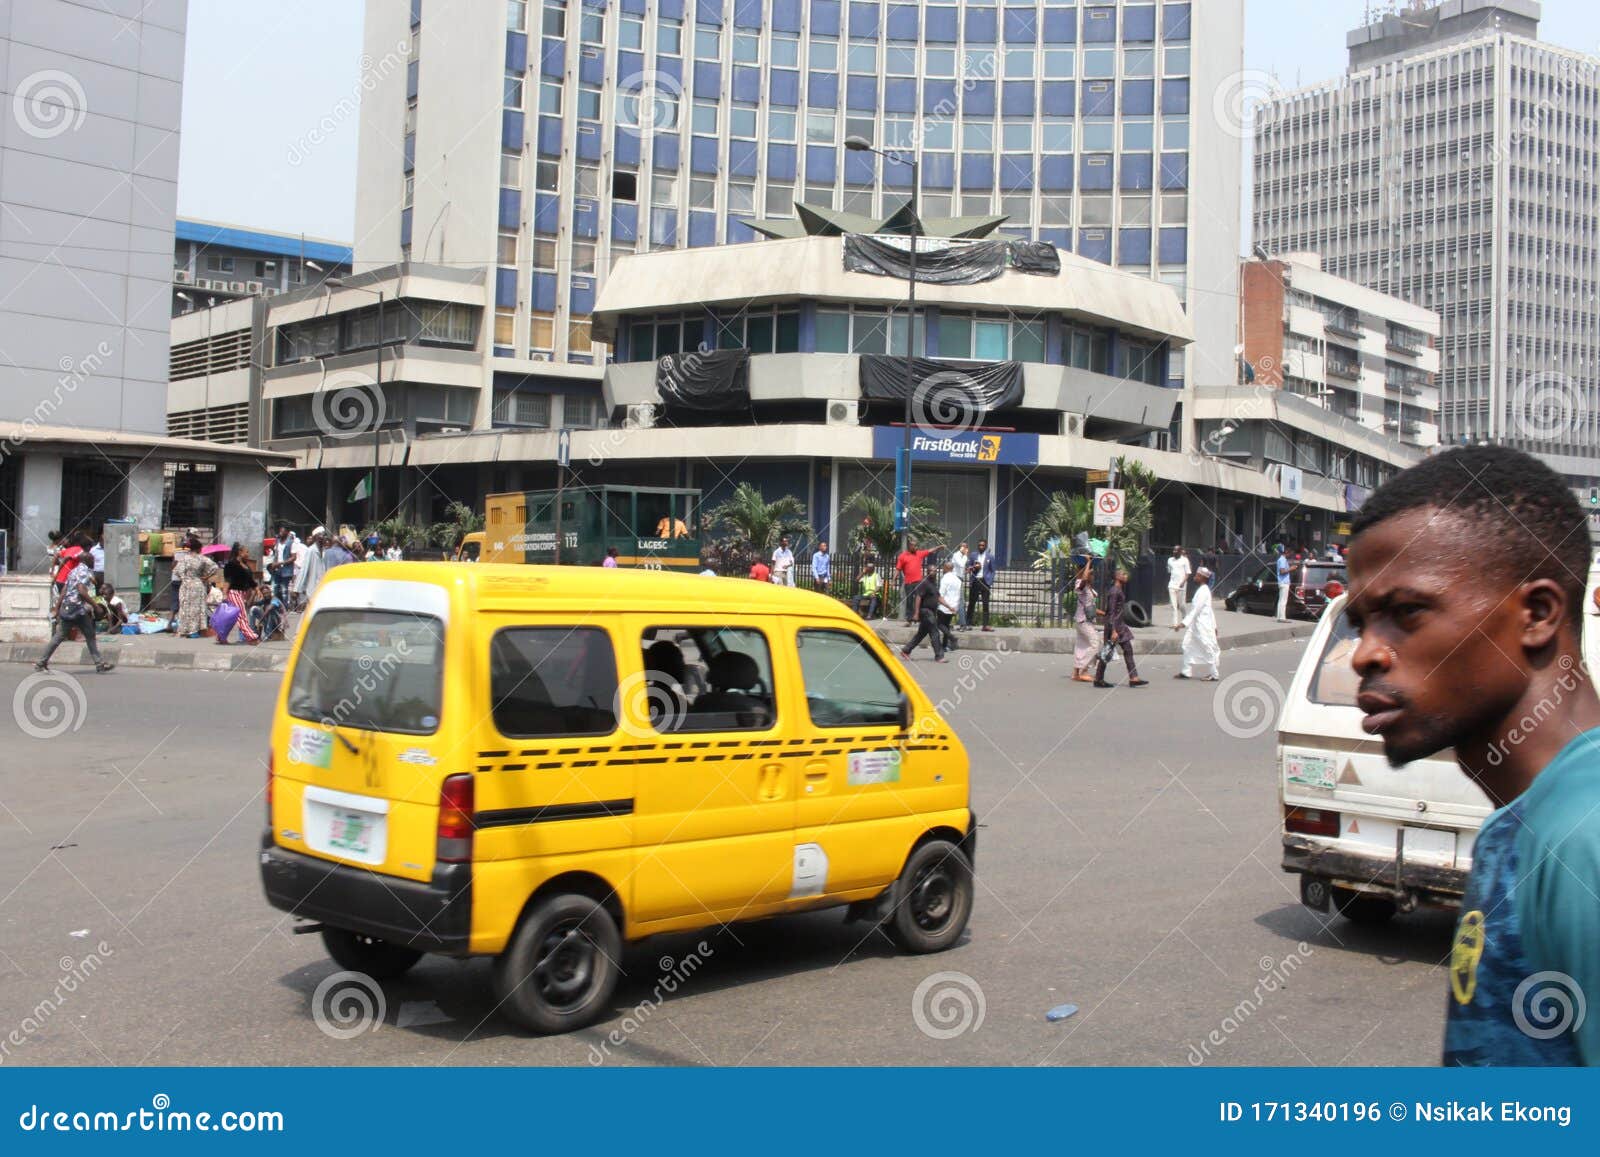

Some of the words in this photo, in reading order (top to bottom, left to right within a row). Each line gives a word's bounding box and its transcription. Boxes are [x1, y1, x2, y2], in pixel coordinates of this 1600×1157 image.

[912, 436, 979, 453] FirstBank
[564, 536, 578, 548] 112
[637, 540, 669, 550] LAGESC
